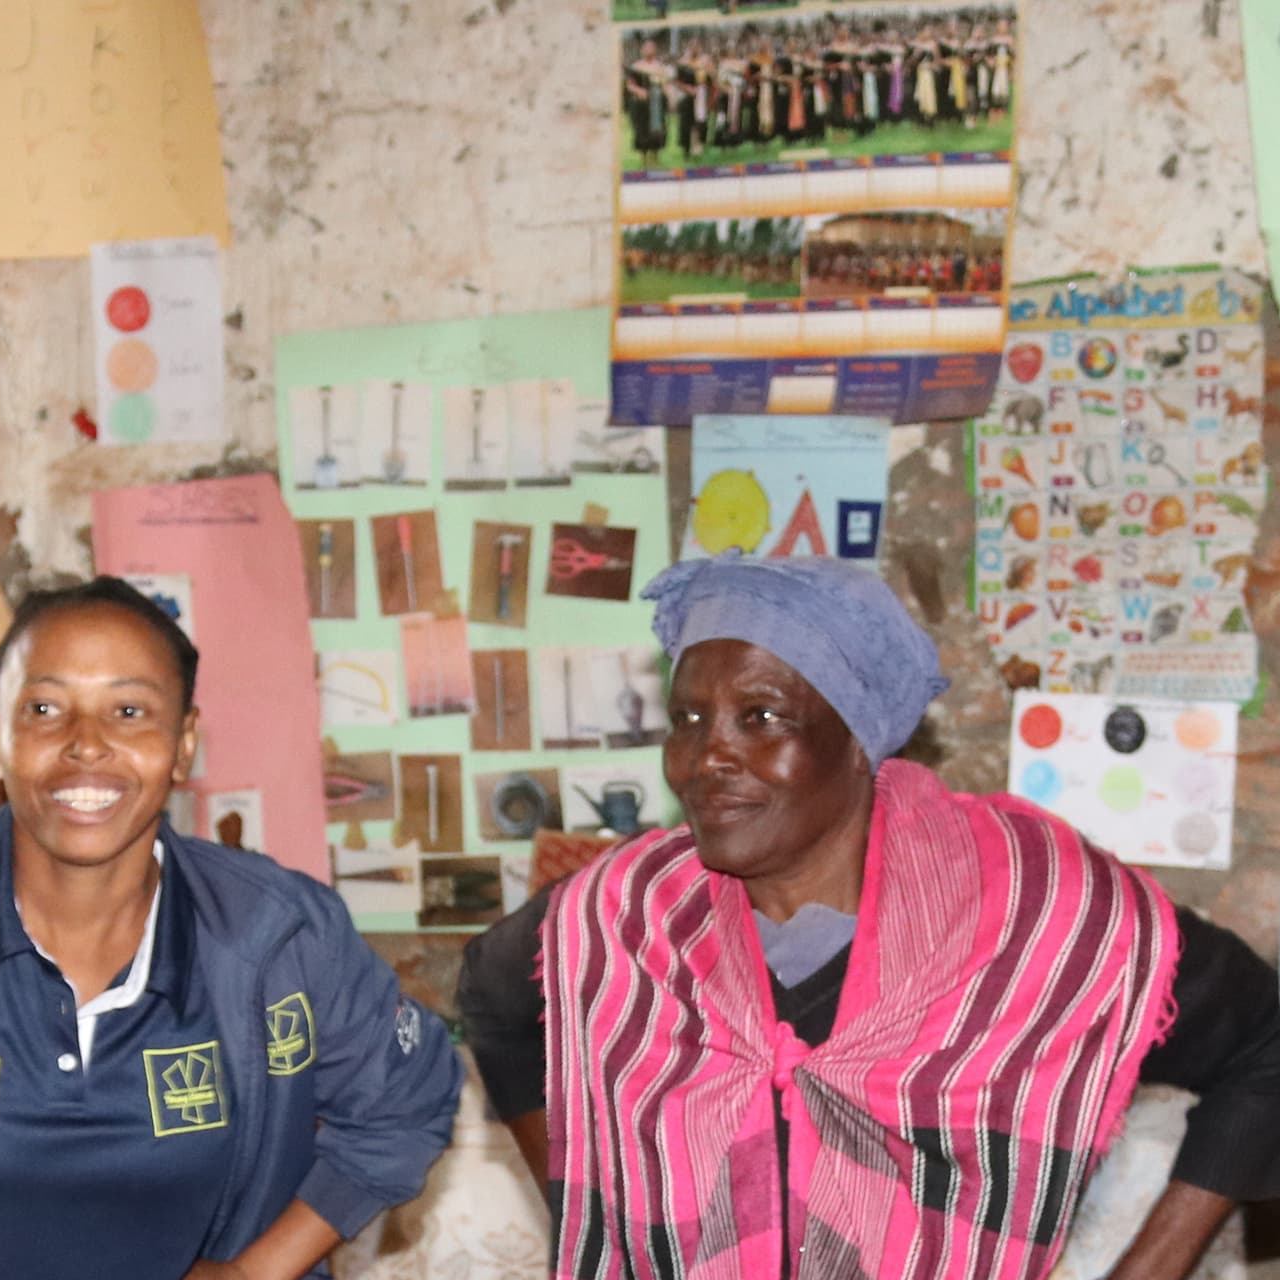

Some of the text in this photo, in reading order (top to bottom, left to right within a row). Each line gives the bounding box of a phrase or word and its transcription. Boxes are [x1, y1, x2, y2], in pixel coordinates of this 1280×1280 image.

[1051, 331, 1071, 358] B
[1196, 328, 1217, 354] D
[1197, 384, 1217, 409] H
[1050, 439, 1065, 465] J
[1122, 438, 1143, 463] K
[1196, 441, 1212, 465] L
[1048, 495, 1069, 517] N
[1123, 493, 1147, 517] O
[1048, 546, 1068, 569] R
[980, 596, 1210, 623] U V W X
[1047, 650, 1066, 676] Z
